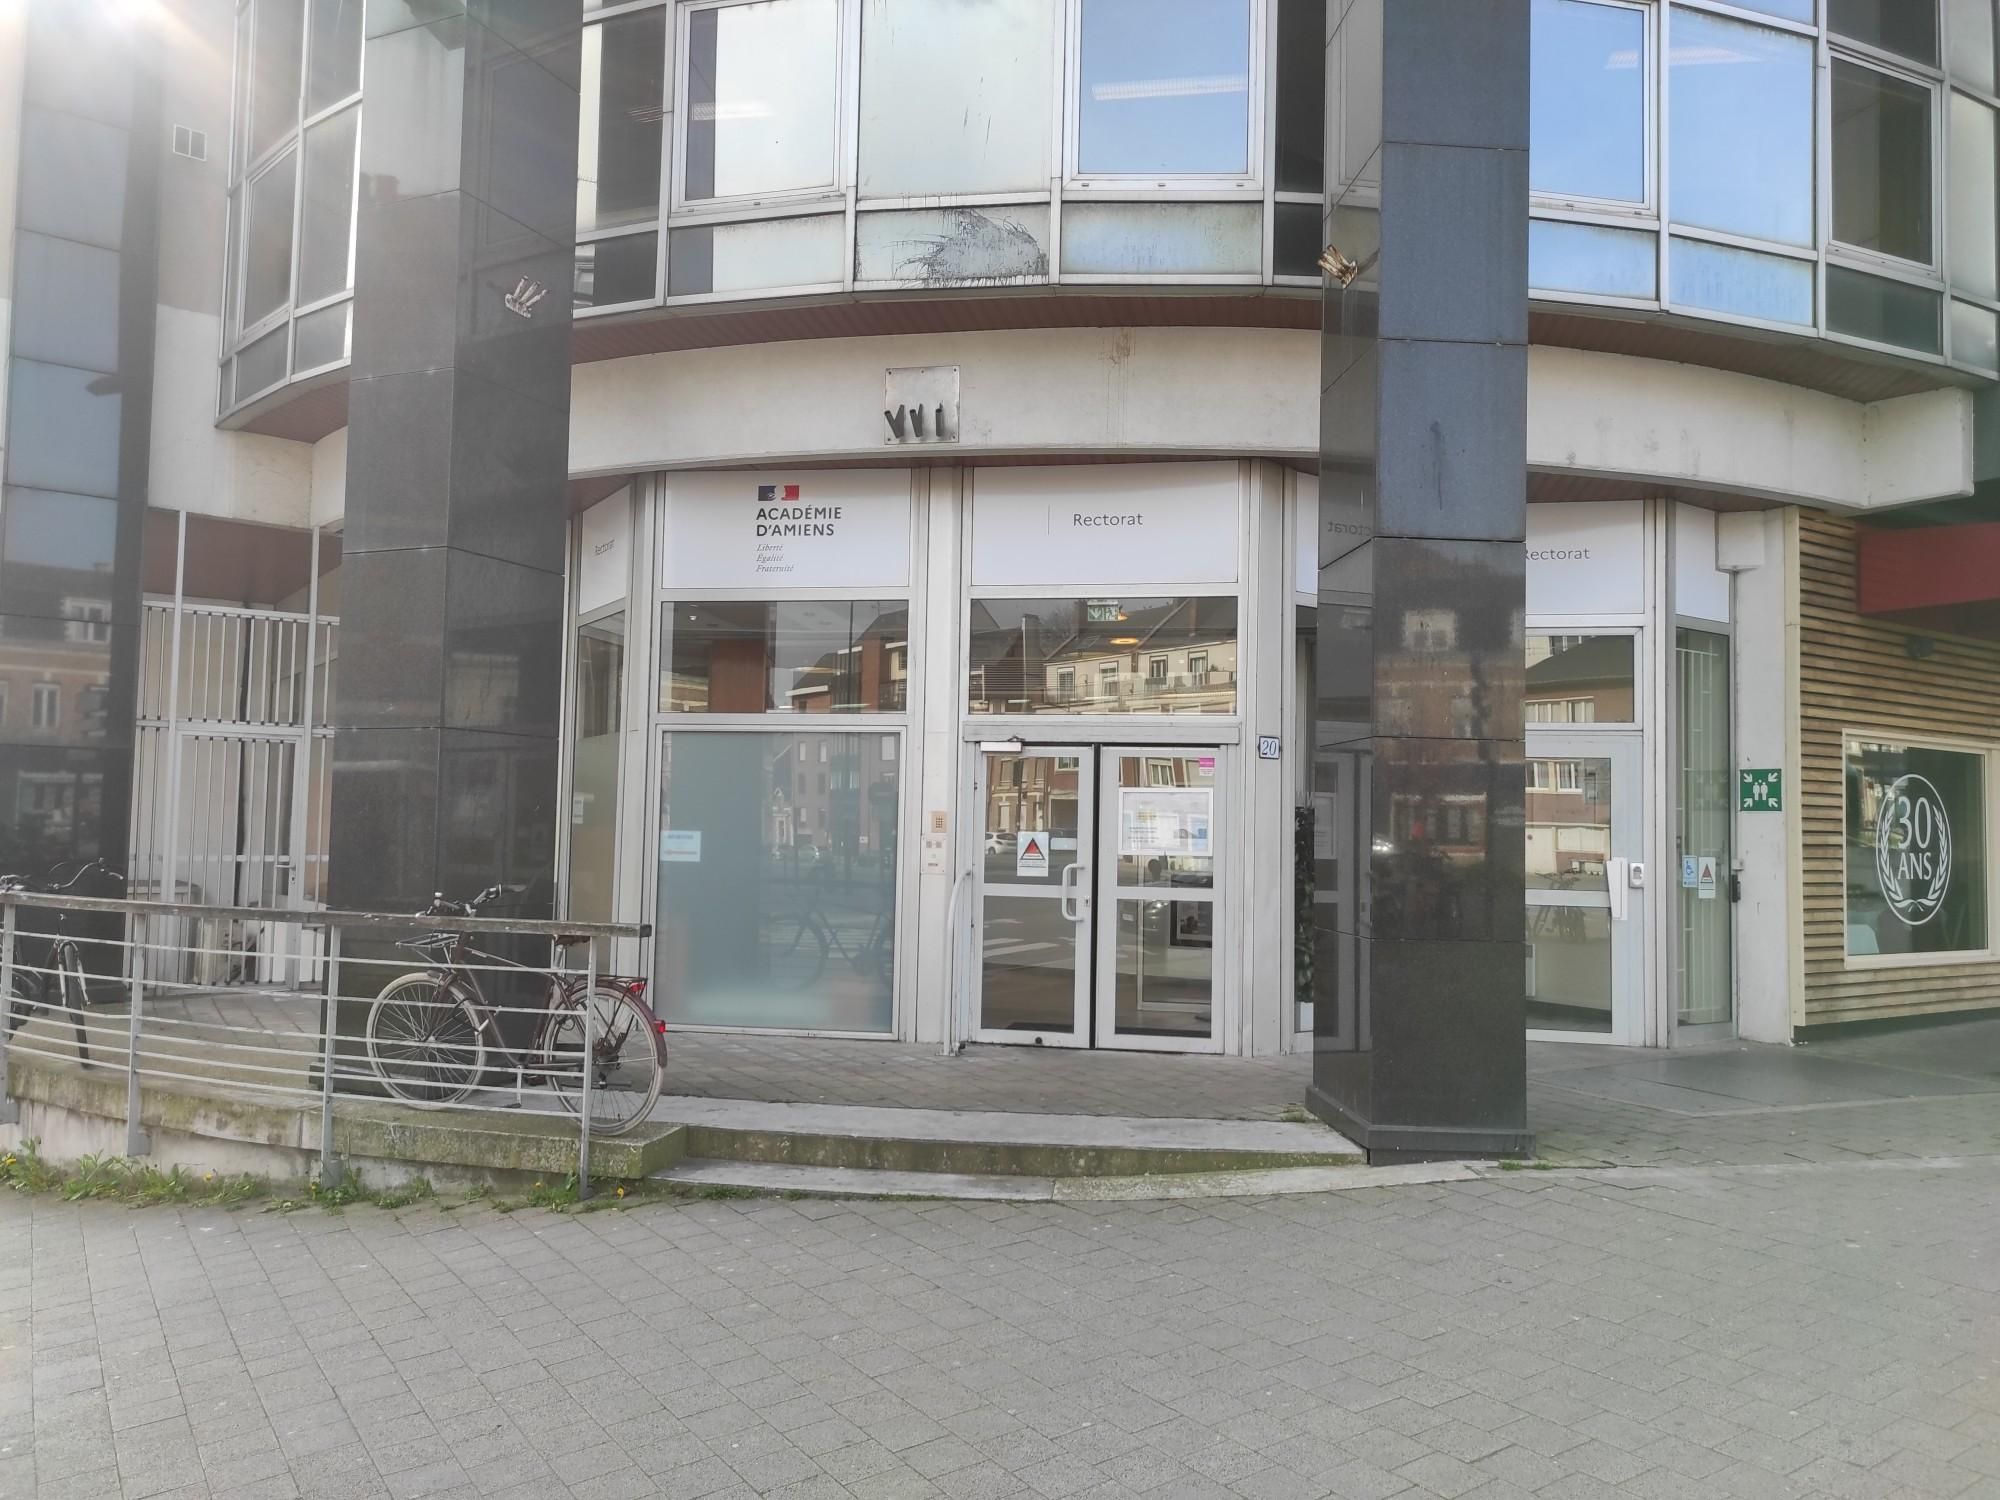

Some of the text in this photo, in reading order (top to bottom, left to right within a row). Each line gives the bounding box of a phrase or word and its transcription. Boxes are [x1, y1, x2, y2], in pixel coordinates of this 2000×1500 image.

[756, 504, 842, 520] ACADÉMIE
[1073, 513, 1144, 526] Rectorat
[756, 523, 834, 537] D'AMIENS
[756, 543, 784, 552] Liberté
[755, 564, 794, 573] Fraternité
[1262, 740, 1277, 756] 20
[1898, 796, 1932, 849] 30
[1897, 852, 1932, 880] ANS
